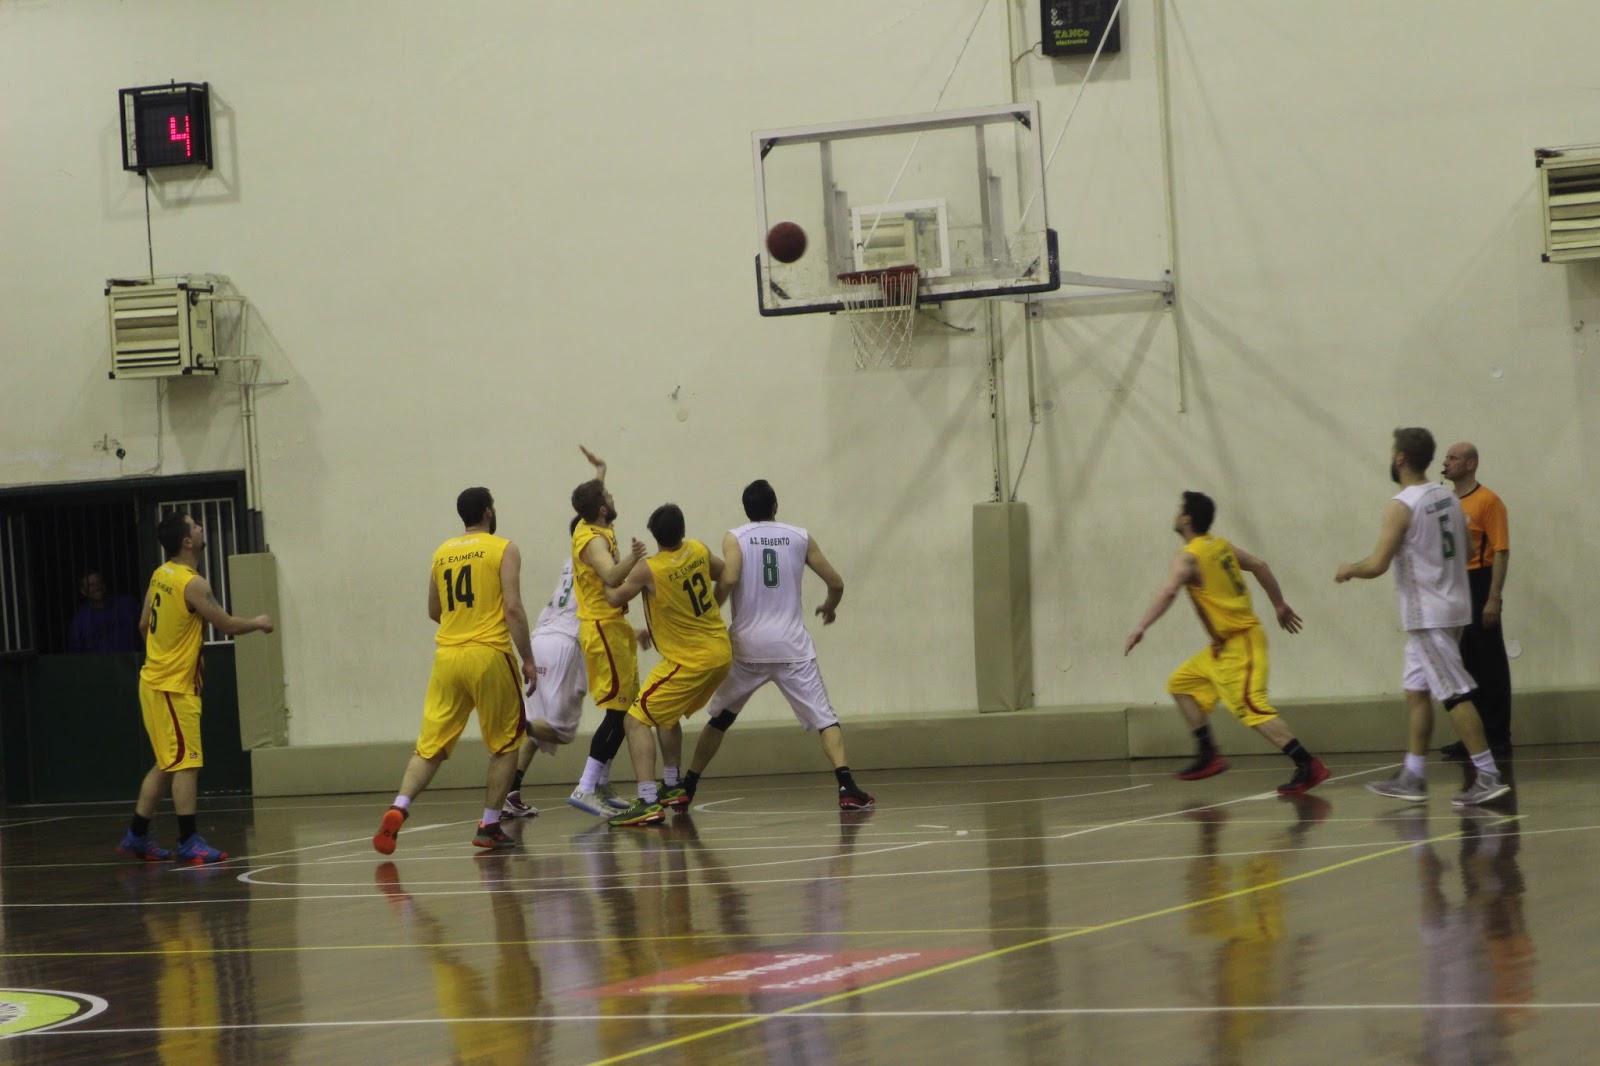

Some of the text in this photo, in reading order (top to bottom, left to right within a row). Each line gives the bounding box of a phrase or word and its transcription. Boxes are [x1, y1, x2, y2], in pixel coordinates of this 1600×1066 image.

[169, 115, 191, 157] 4
[1438, 513, 1456, 560] 5
[443, 563, 475, 612] 14
[762, 548, 779, 589] 8
[149, 592, 161, 635] 6
[683, 572, 713, 618] 12
